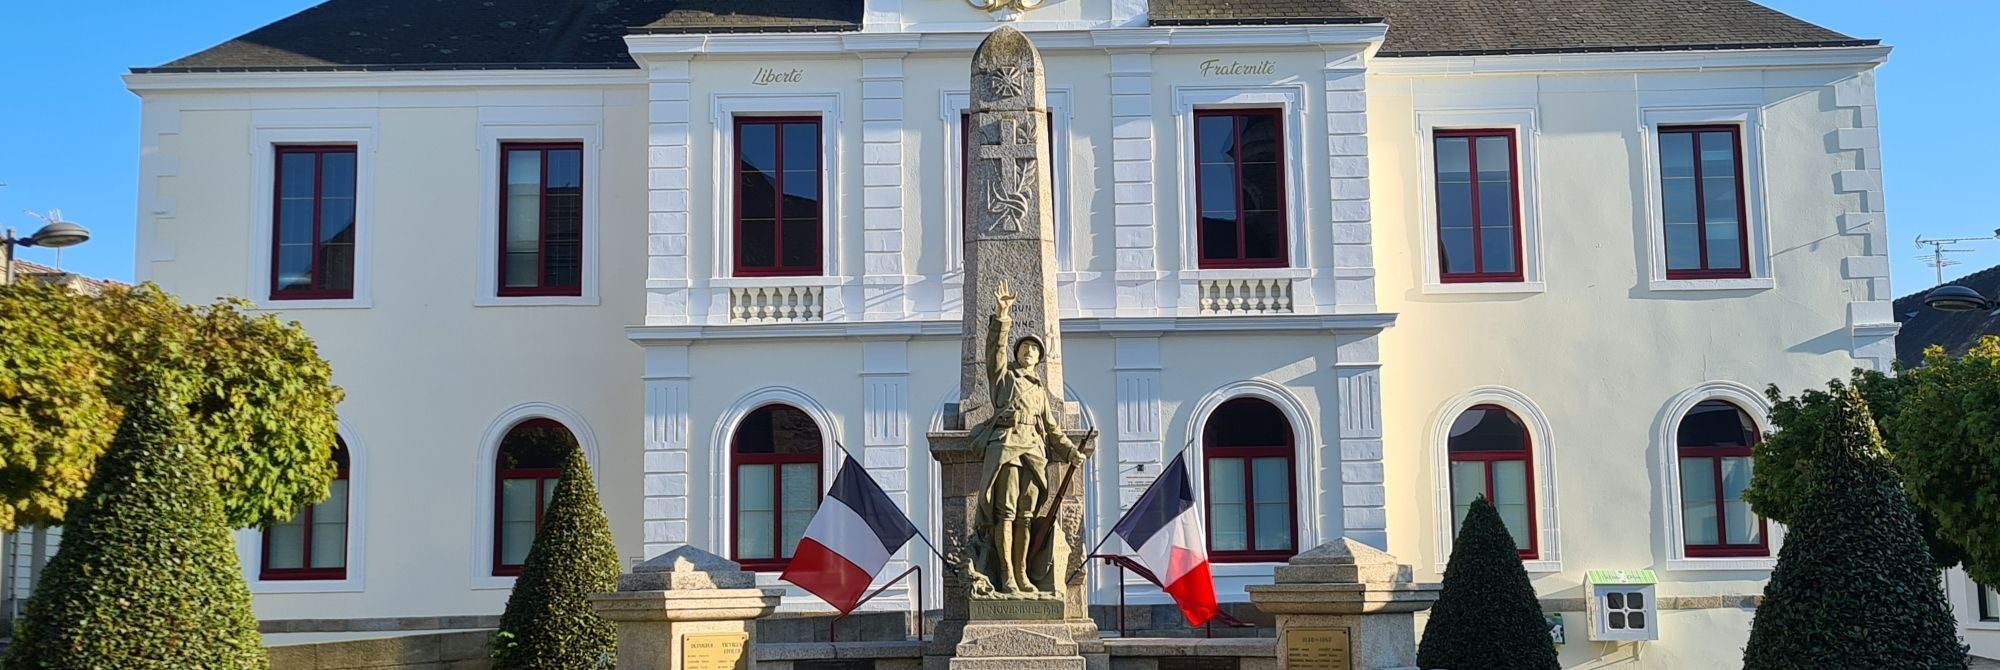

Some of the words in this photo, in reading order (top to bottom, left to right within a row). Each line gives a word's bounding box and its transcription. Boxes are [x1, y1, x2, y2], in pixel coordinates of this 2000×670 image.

[752, 67, 804, 86] Liberté
[1200, 59, 1276, 77] Fraternité
[992, 304, 1032, 313] VDUN
